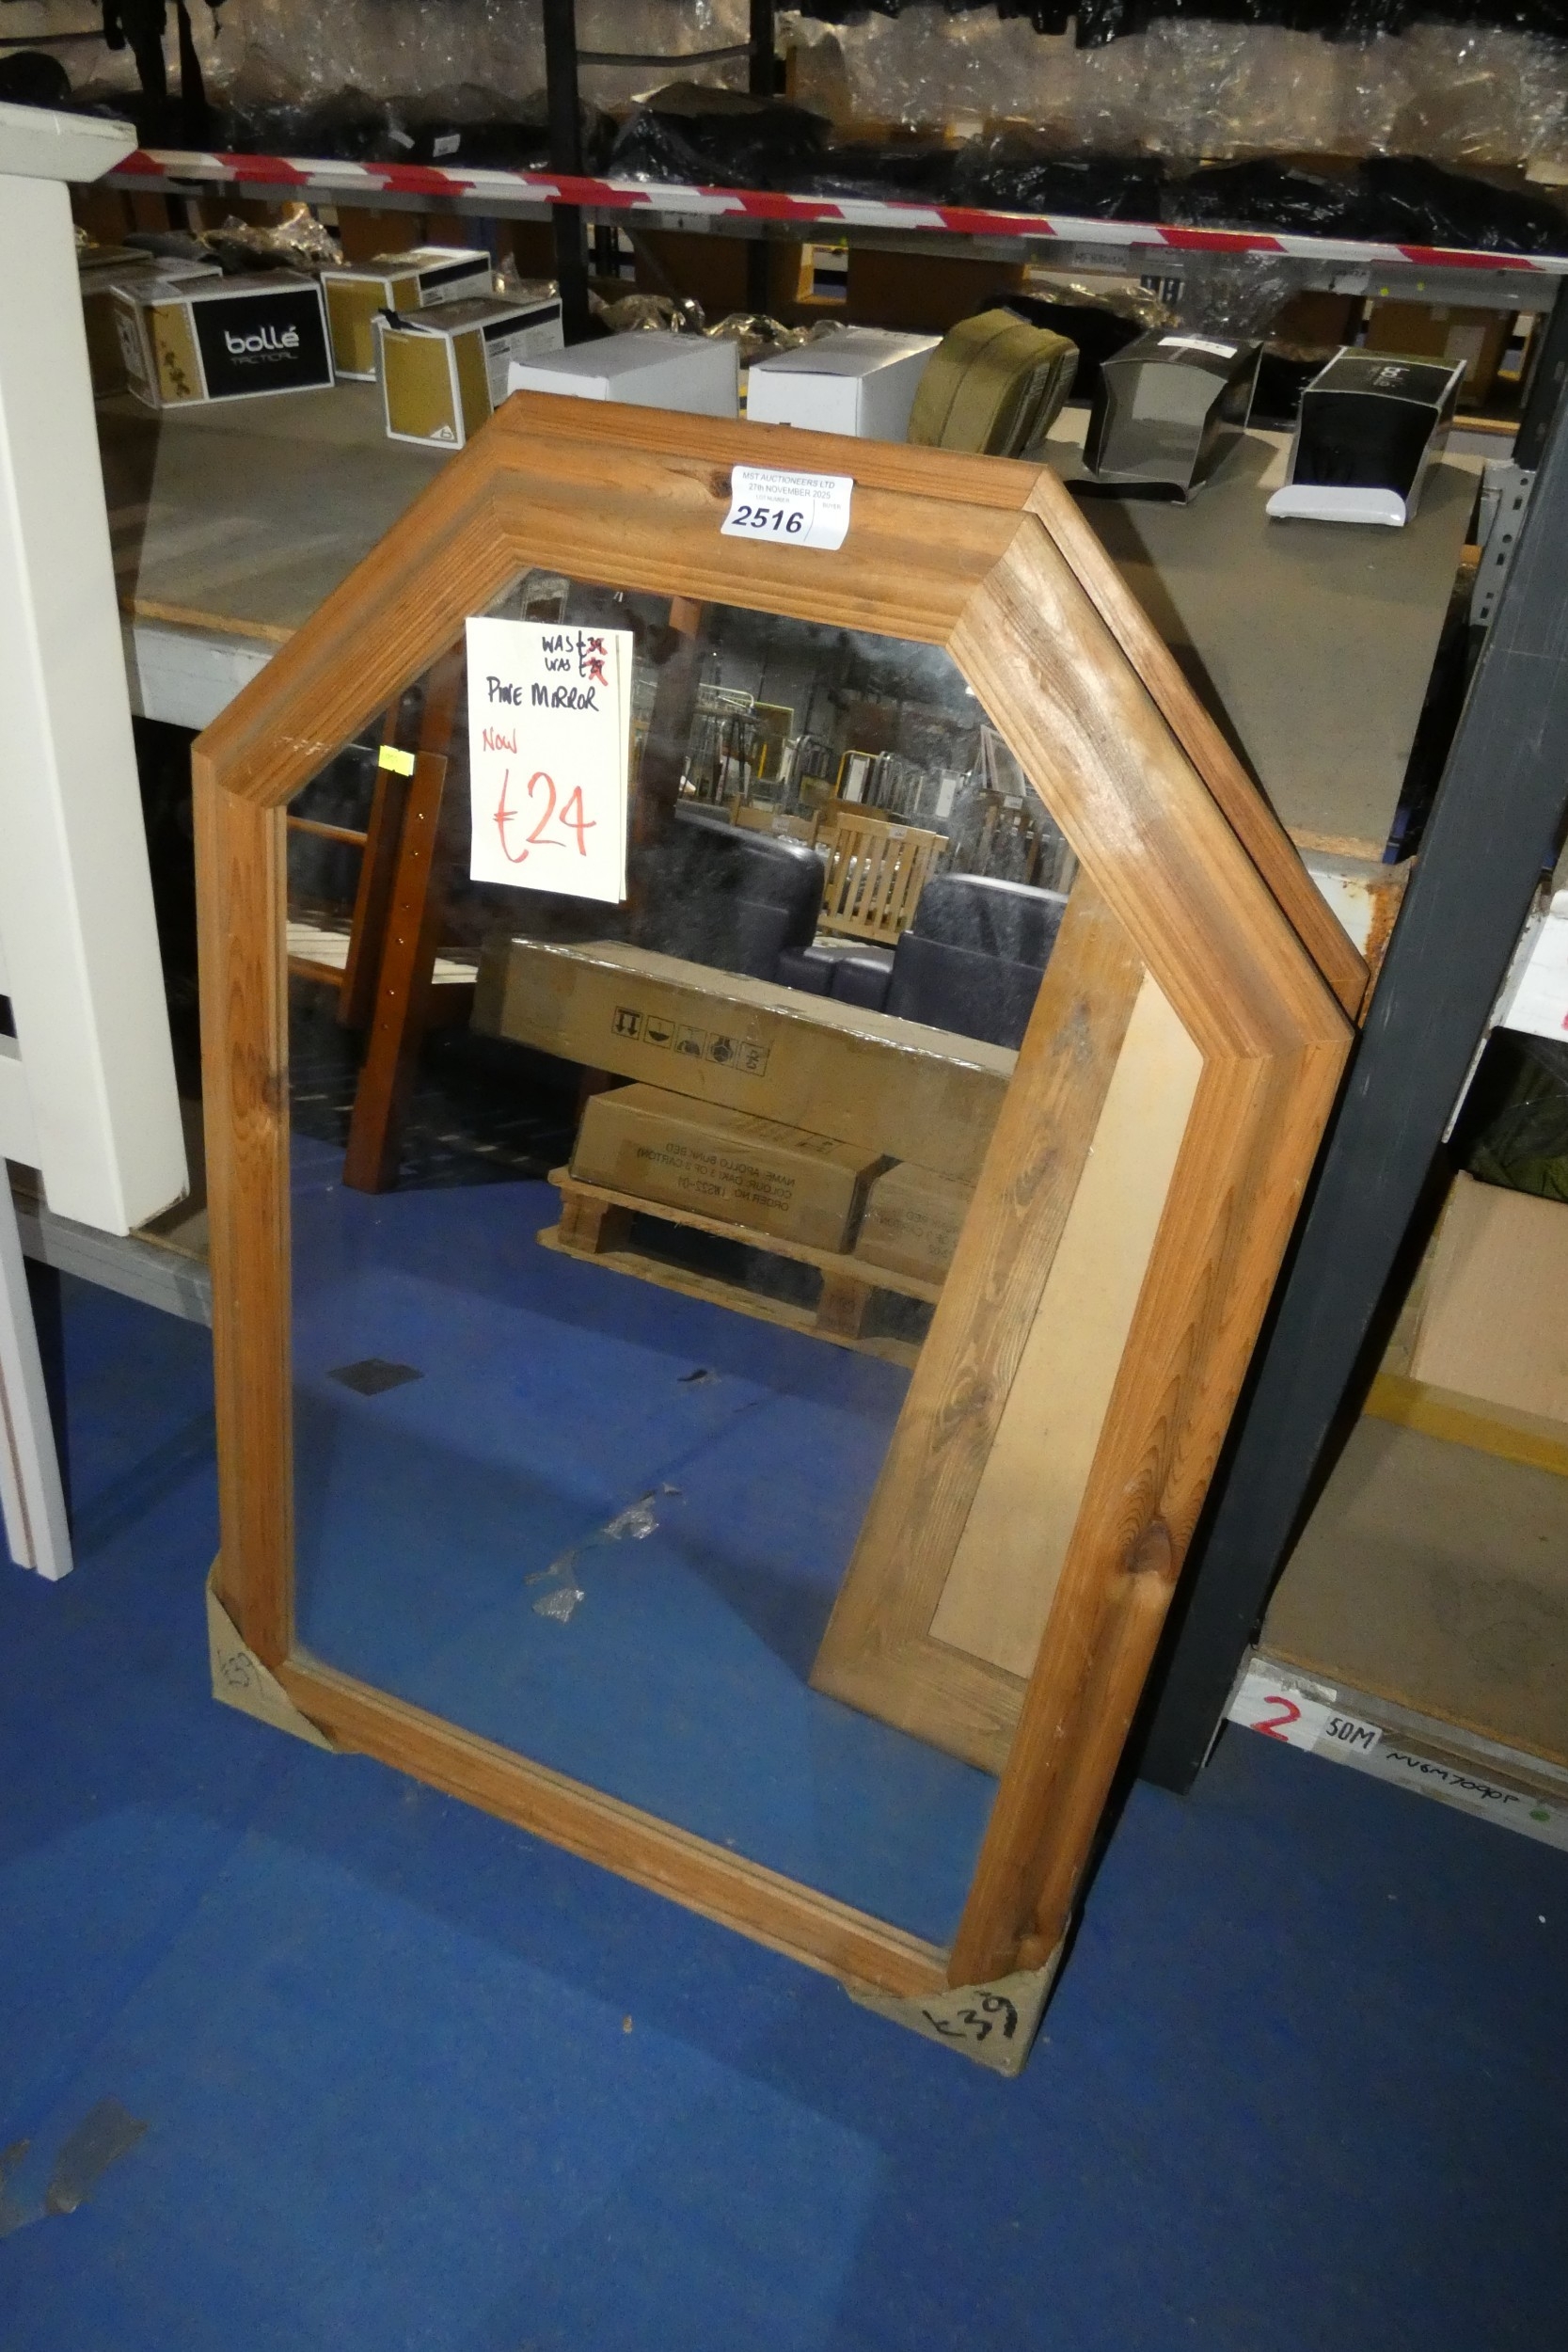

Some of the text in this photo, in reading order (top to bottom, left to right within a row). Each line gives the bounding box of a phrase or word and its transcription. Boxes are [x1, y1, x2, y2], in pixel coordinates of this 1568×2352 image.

[224, 326, 300, 354] bollé
[230, 352, 298, 365] TACTICAL
[742, 471, 835, 489] MST AUCTIONEERS LTD
[749, 483, 832, 500] 27th NOVEMBER 2025
[732, 505, 804, 533] 2516
[542, 634, 574, 654] WAS
[531, 683, 599, 712] MIRROR
[1250, 1695, 1302, 1742] 2
